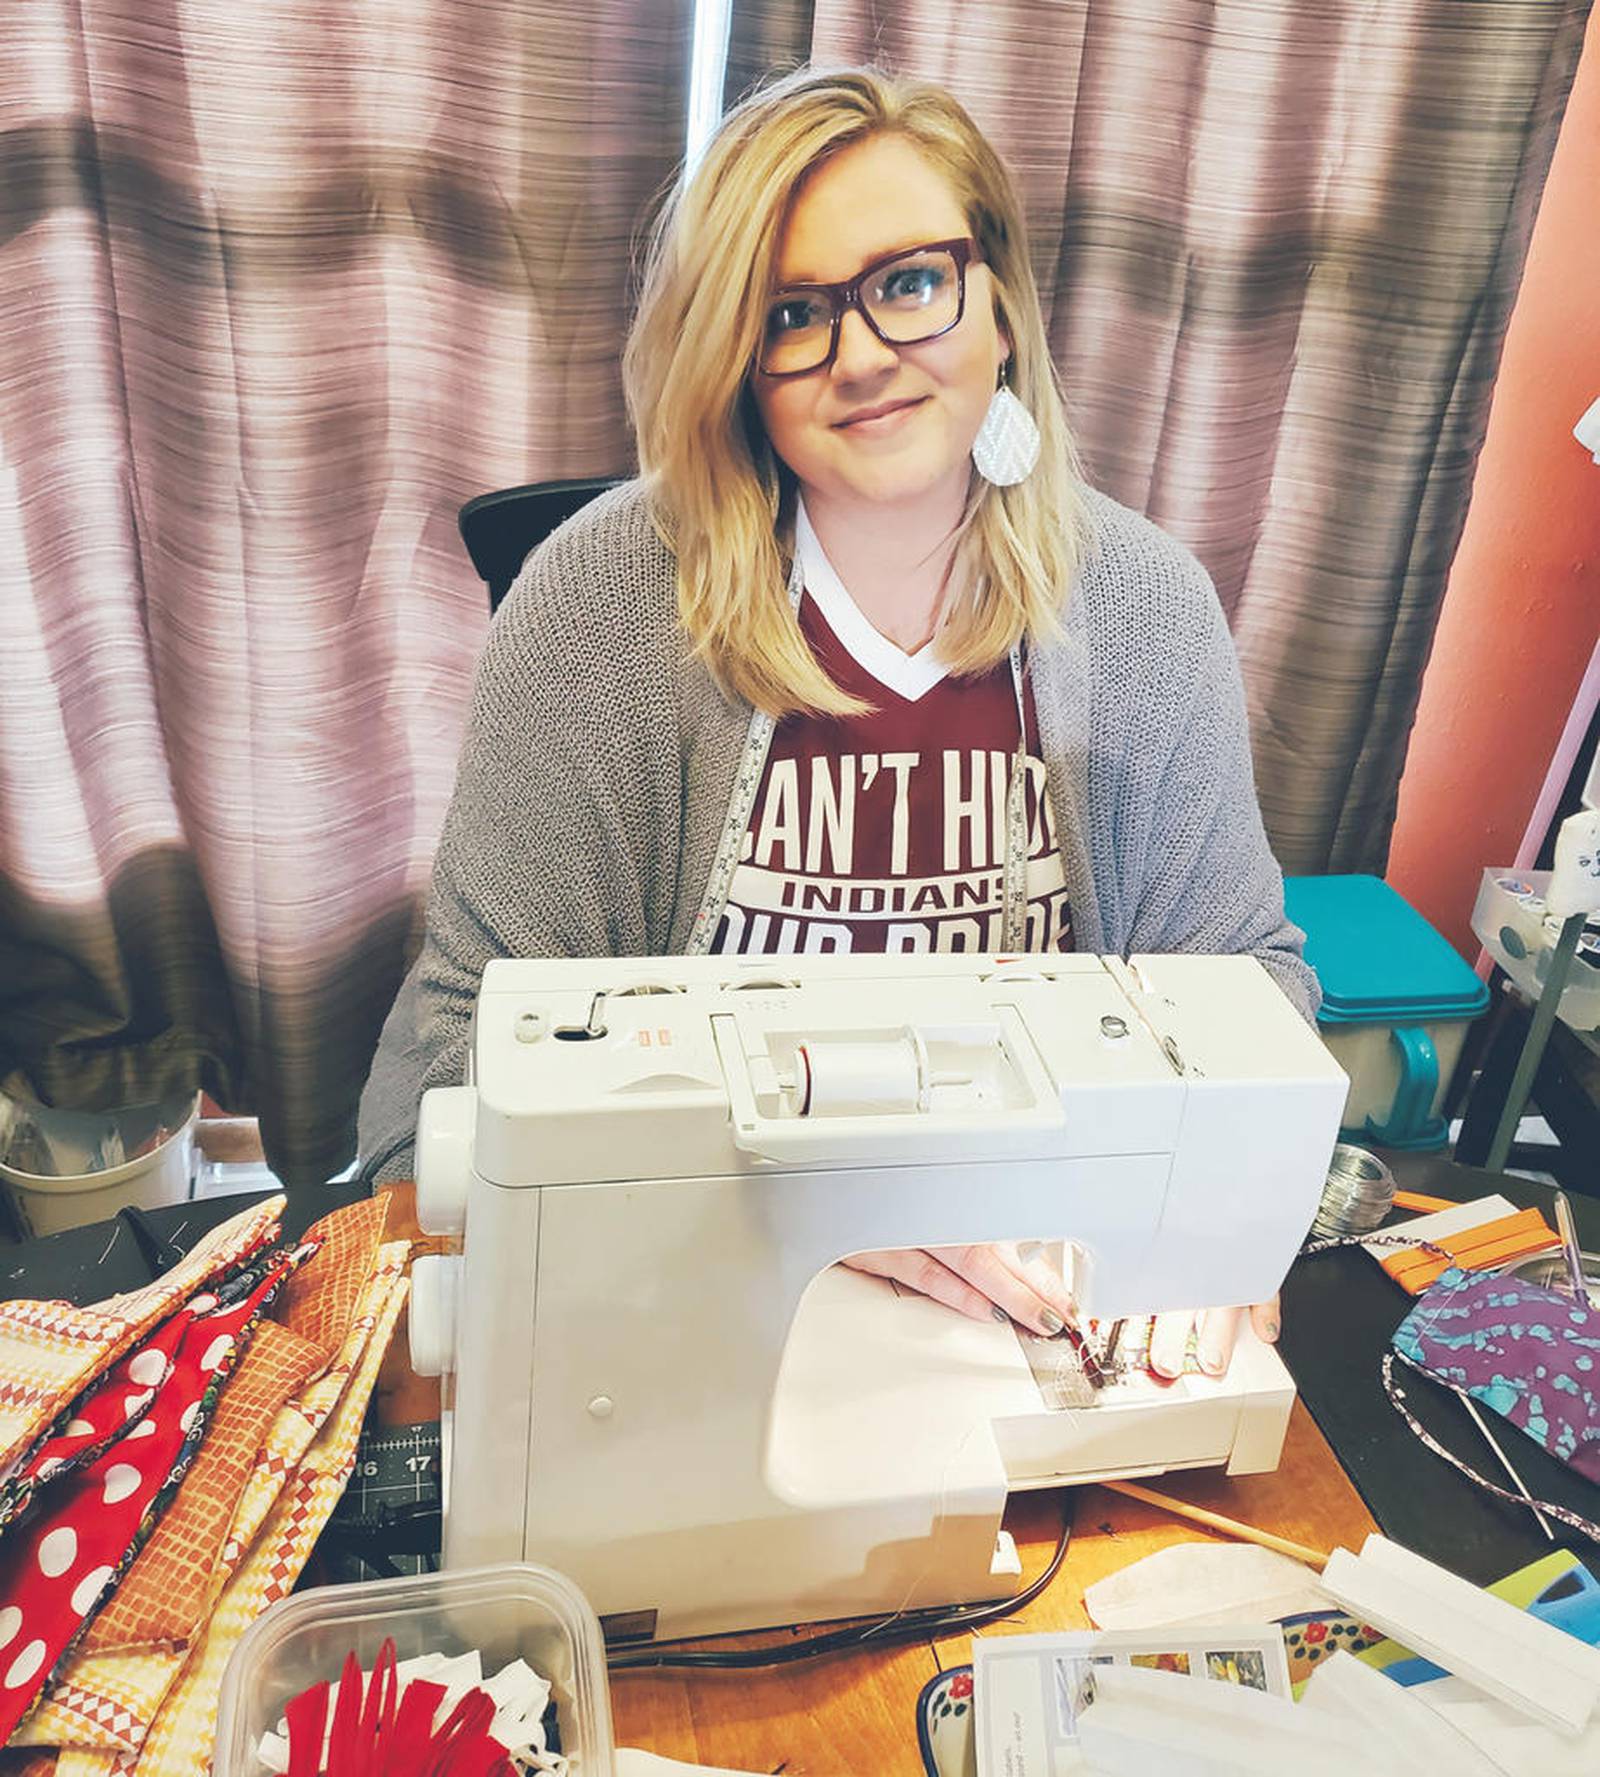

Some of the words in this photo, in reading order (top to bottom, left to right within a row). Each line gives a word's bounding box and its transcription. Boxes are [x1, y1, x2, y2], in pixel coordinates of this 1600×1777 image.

[740, 752, 919, 875] AN'T
[943, 749, 1057, 870] HID
[781, 876, 1003, 913] INDIAN
[405, 1455, 431, 1472] 17
